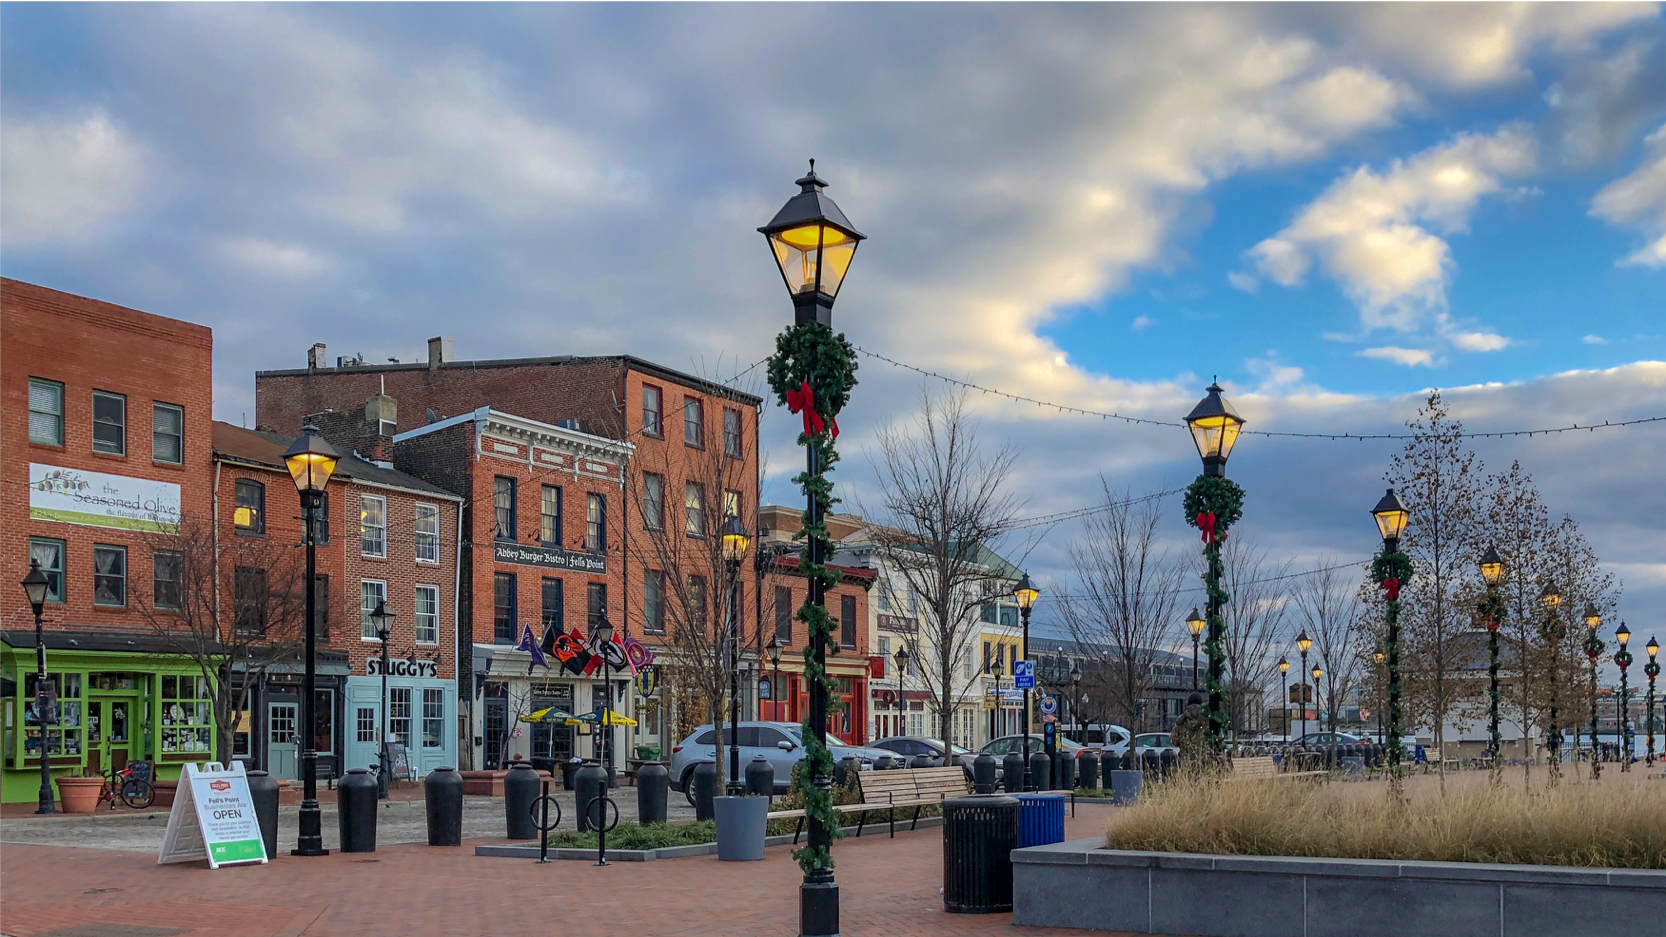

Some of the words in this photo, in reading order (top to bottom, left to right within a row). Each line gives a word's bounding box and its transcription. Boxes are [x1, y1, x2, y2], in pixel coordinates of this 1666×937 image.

[103, 482, 119, 495] the
[73, 491, 140, 510] Seasoned
[144, 497, 176, 514] Olive
[106, 508, 116, 516] the
[496, 548, 518, 560] Abbey
[520, 550, 543, 562] Burger
[544, 552, 565, 564] Bistro
[586, 558, 604, 570] Point
[368, 660, 438, 677] STUGGY'S
[214, 810, 242, 820] OPEN
